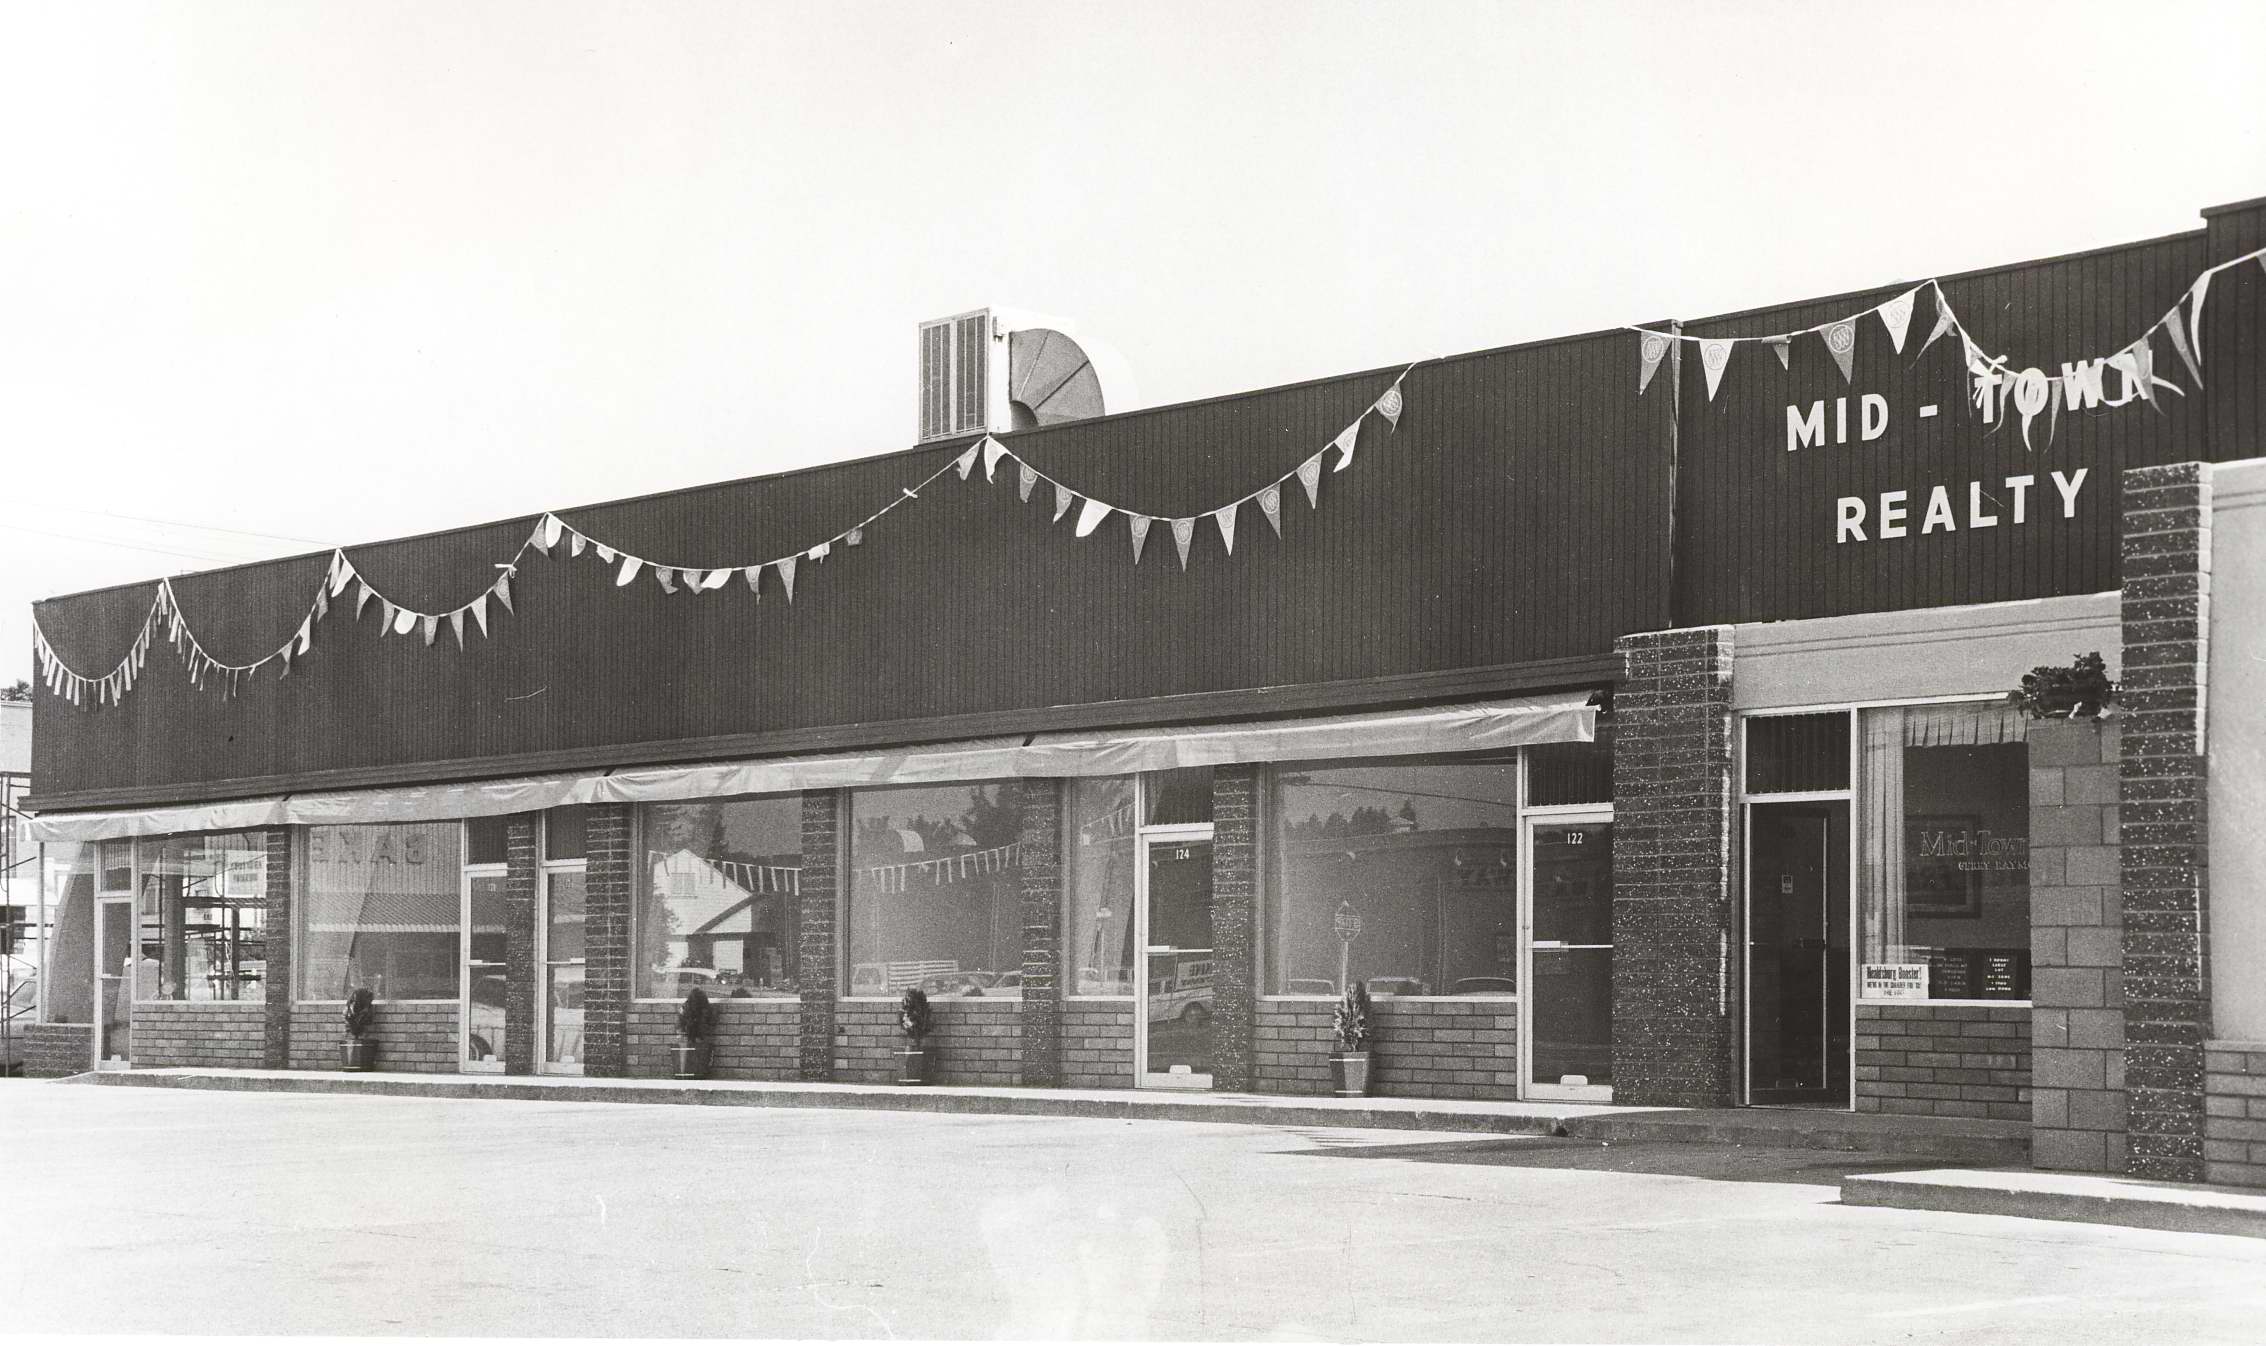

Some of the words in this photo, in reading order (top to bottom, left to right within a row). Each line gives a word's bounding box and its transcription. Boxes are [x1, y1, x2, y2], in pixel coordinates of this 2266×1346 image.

[1786, 393, 1889, 452] MID
[1837, 468, 2089, 544] REALTY
[1175, 848, 1190, 860] 124
[1567, 832, 1583, 845] 122
